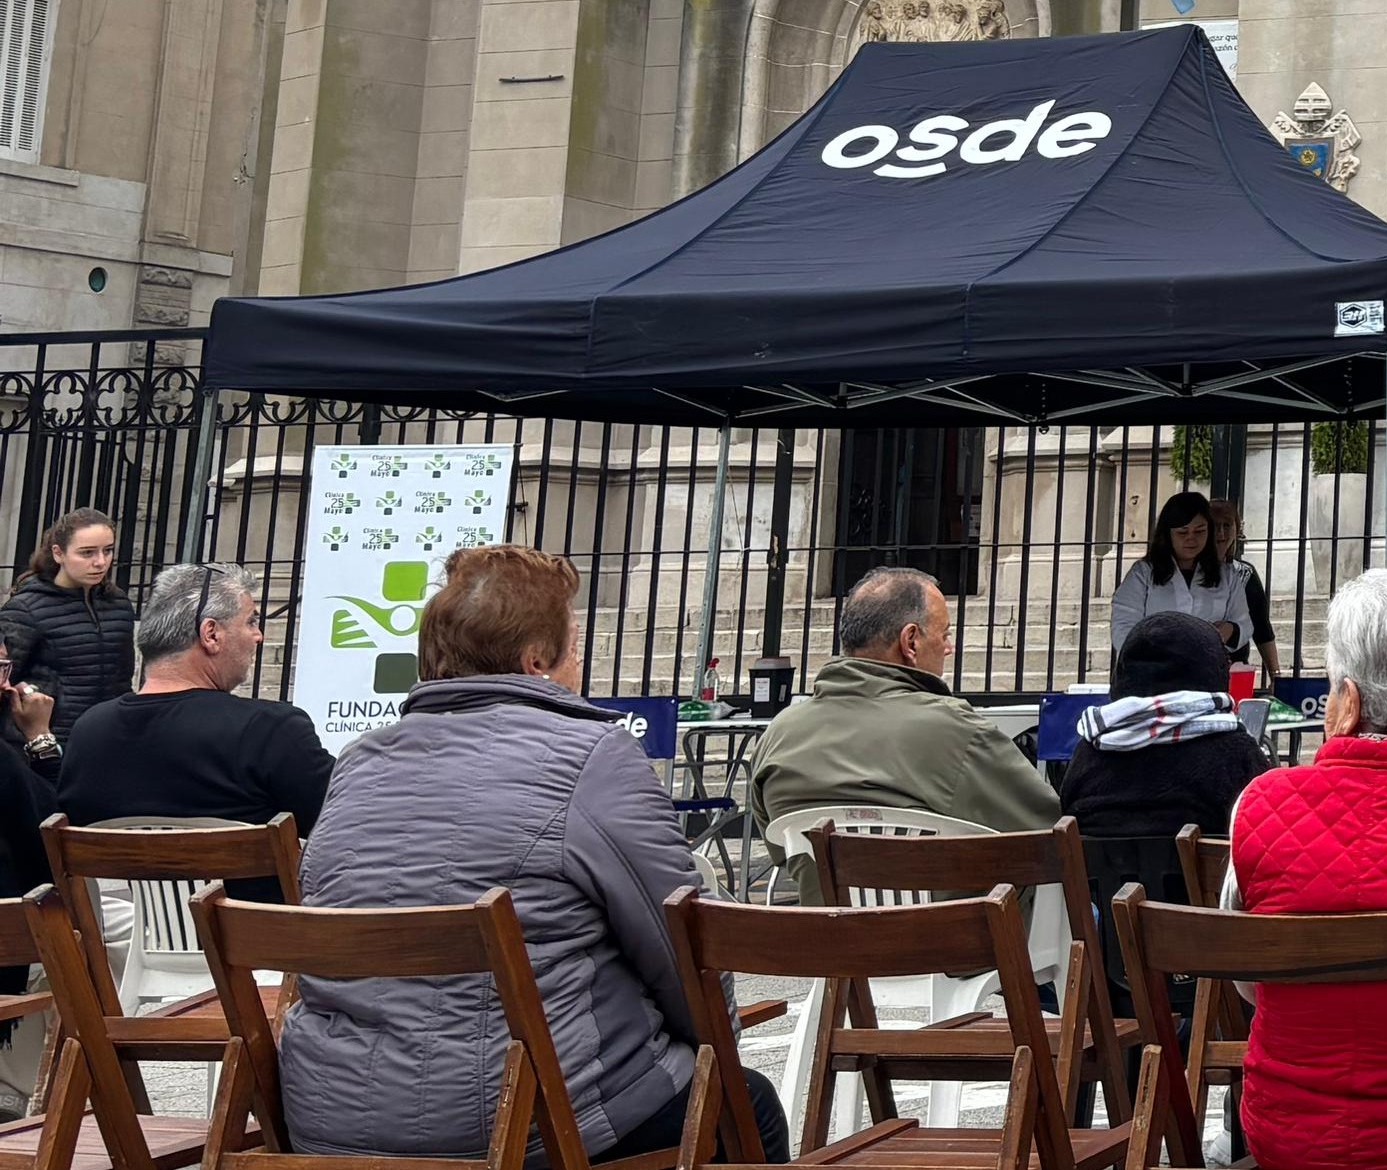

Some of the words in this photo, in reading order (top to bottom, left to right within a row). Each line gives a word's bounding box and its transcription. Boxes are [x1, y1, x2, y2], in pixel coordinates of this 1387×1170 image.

[821, 99, 1112, 178] osde
[328, 701, 405, 718] FUNDA
[325, 720, 372, 732] CLÍNICA
